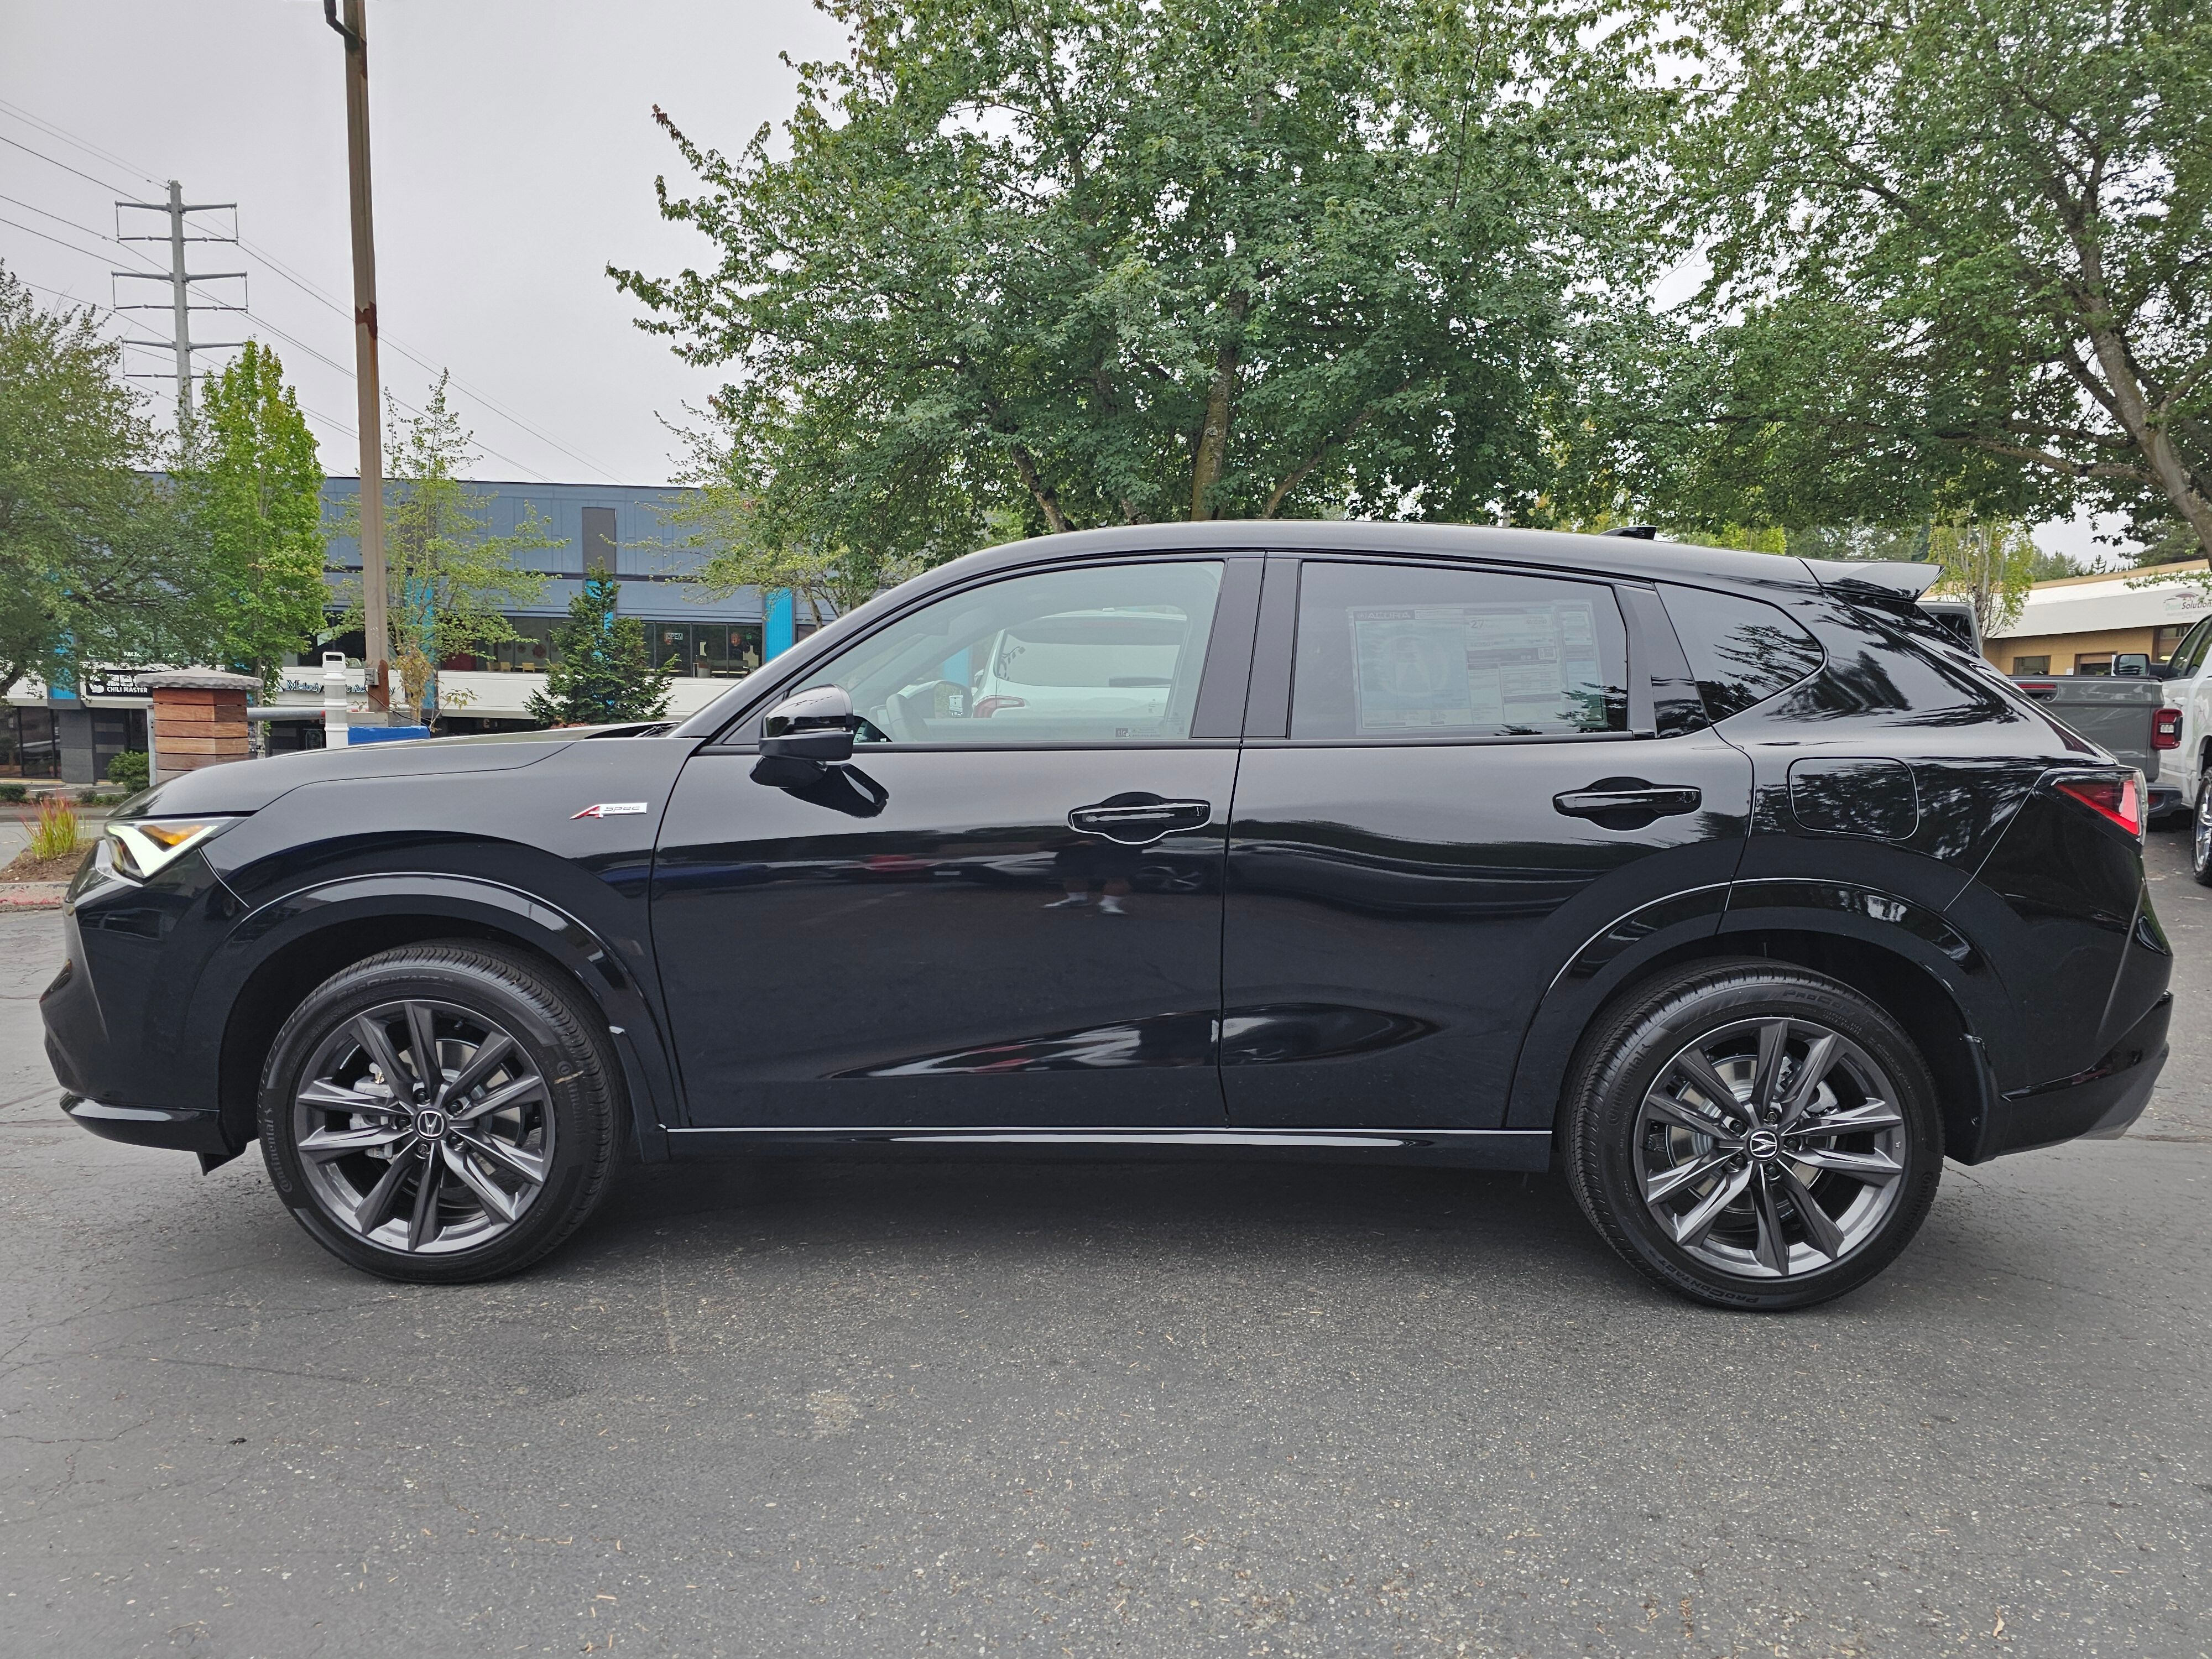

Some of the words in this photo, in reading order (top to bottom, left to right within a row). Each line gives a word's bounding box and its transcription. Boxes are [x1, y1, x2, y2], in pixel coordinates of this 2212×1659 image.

[2182, 601, 2212, 609] Solution
[1470, 620, 1484, 629] 27
[286, 680, 325, 693] Melody
